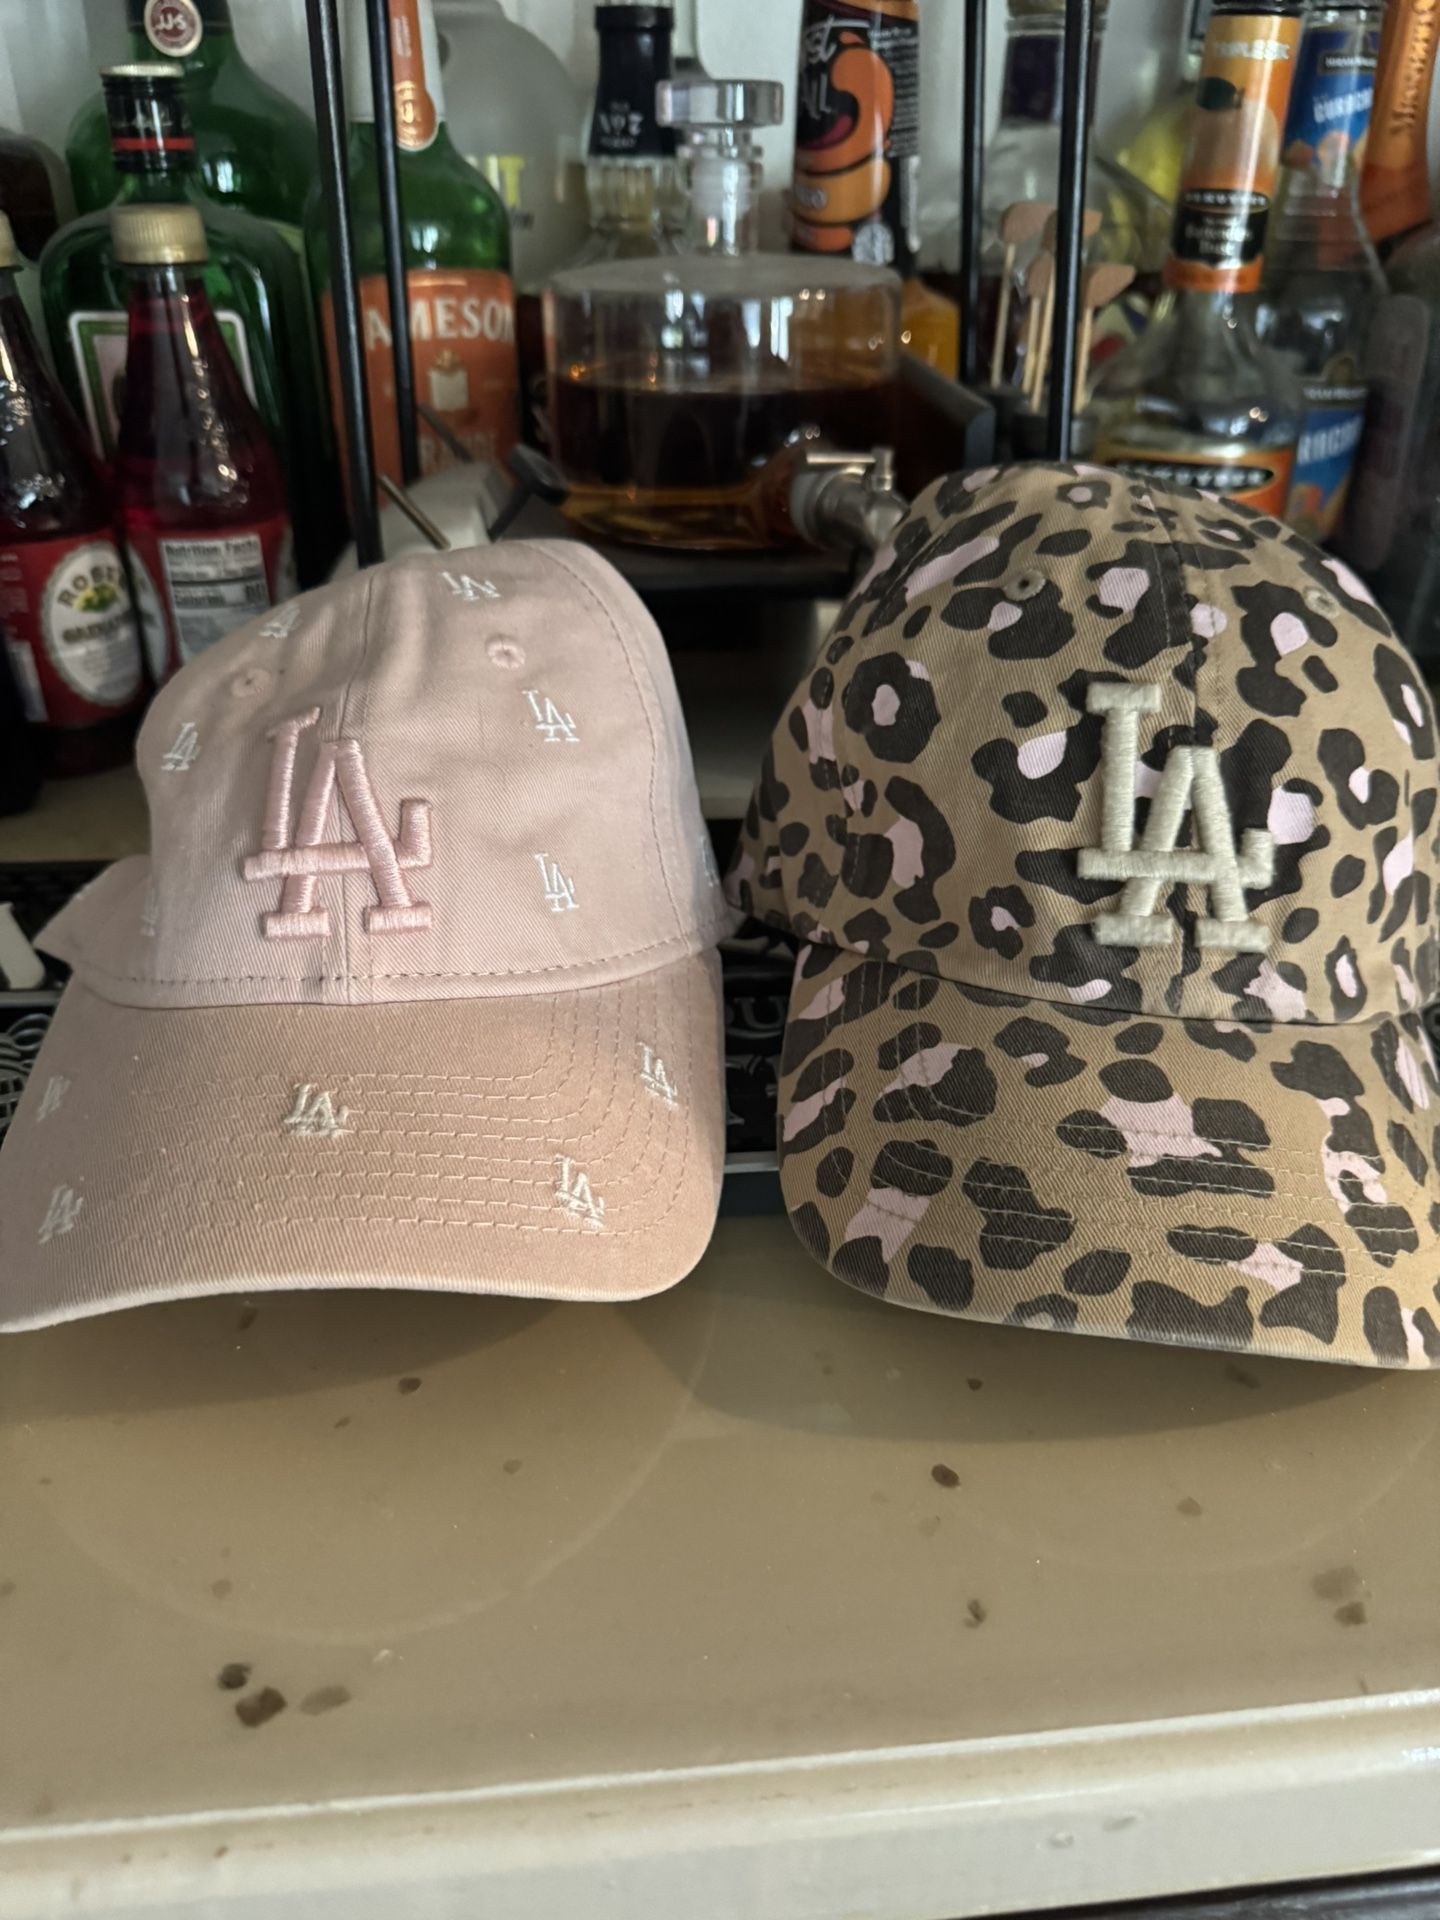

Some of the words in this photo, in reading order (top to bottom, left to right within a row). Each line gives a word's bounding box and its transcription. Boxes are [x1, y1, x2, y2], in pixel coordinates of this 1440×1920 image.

[364, 296, 516, 351] AMESON
[522, 688, 580, 742] LA
[243, 706, 433, 942] LA
[1076, 681, 1277, 953] LA
[534, 852, 580, 912] LA
[554, 1153, 605, 1230] LA
